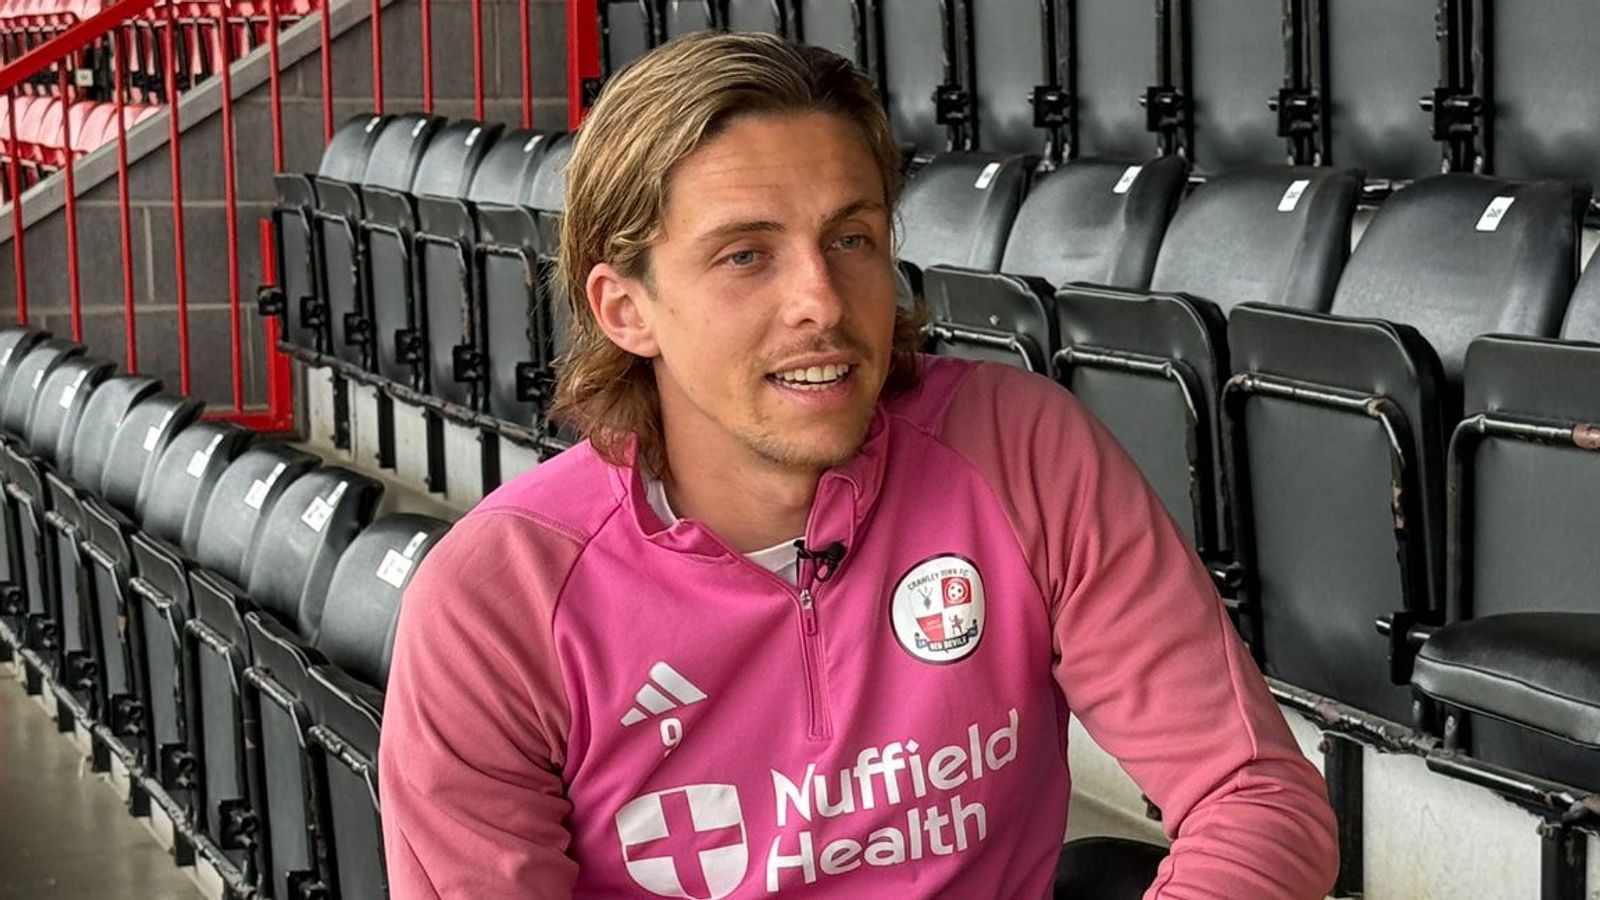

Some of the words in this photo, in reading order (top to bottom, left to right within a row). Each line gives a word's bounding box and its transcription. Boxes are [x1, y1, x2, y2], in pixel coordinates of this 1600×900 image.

[907, 573, 939, 591] CRAWLEY
[959, 568, 970, 577] FC
[770, 707, 1020, 828] Nuffield
[765, 793, 989, 894] Health
